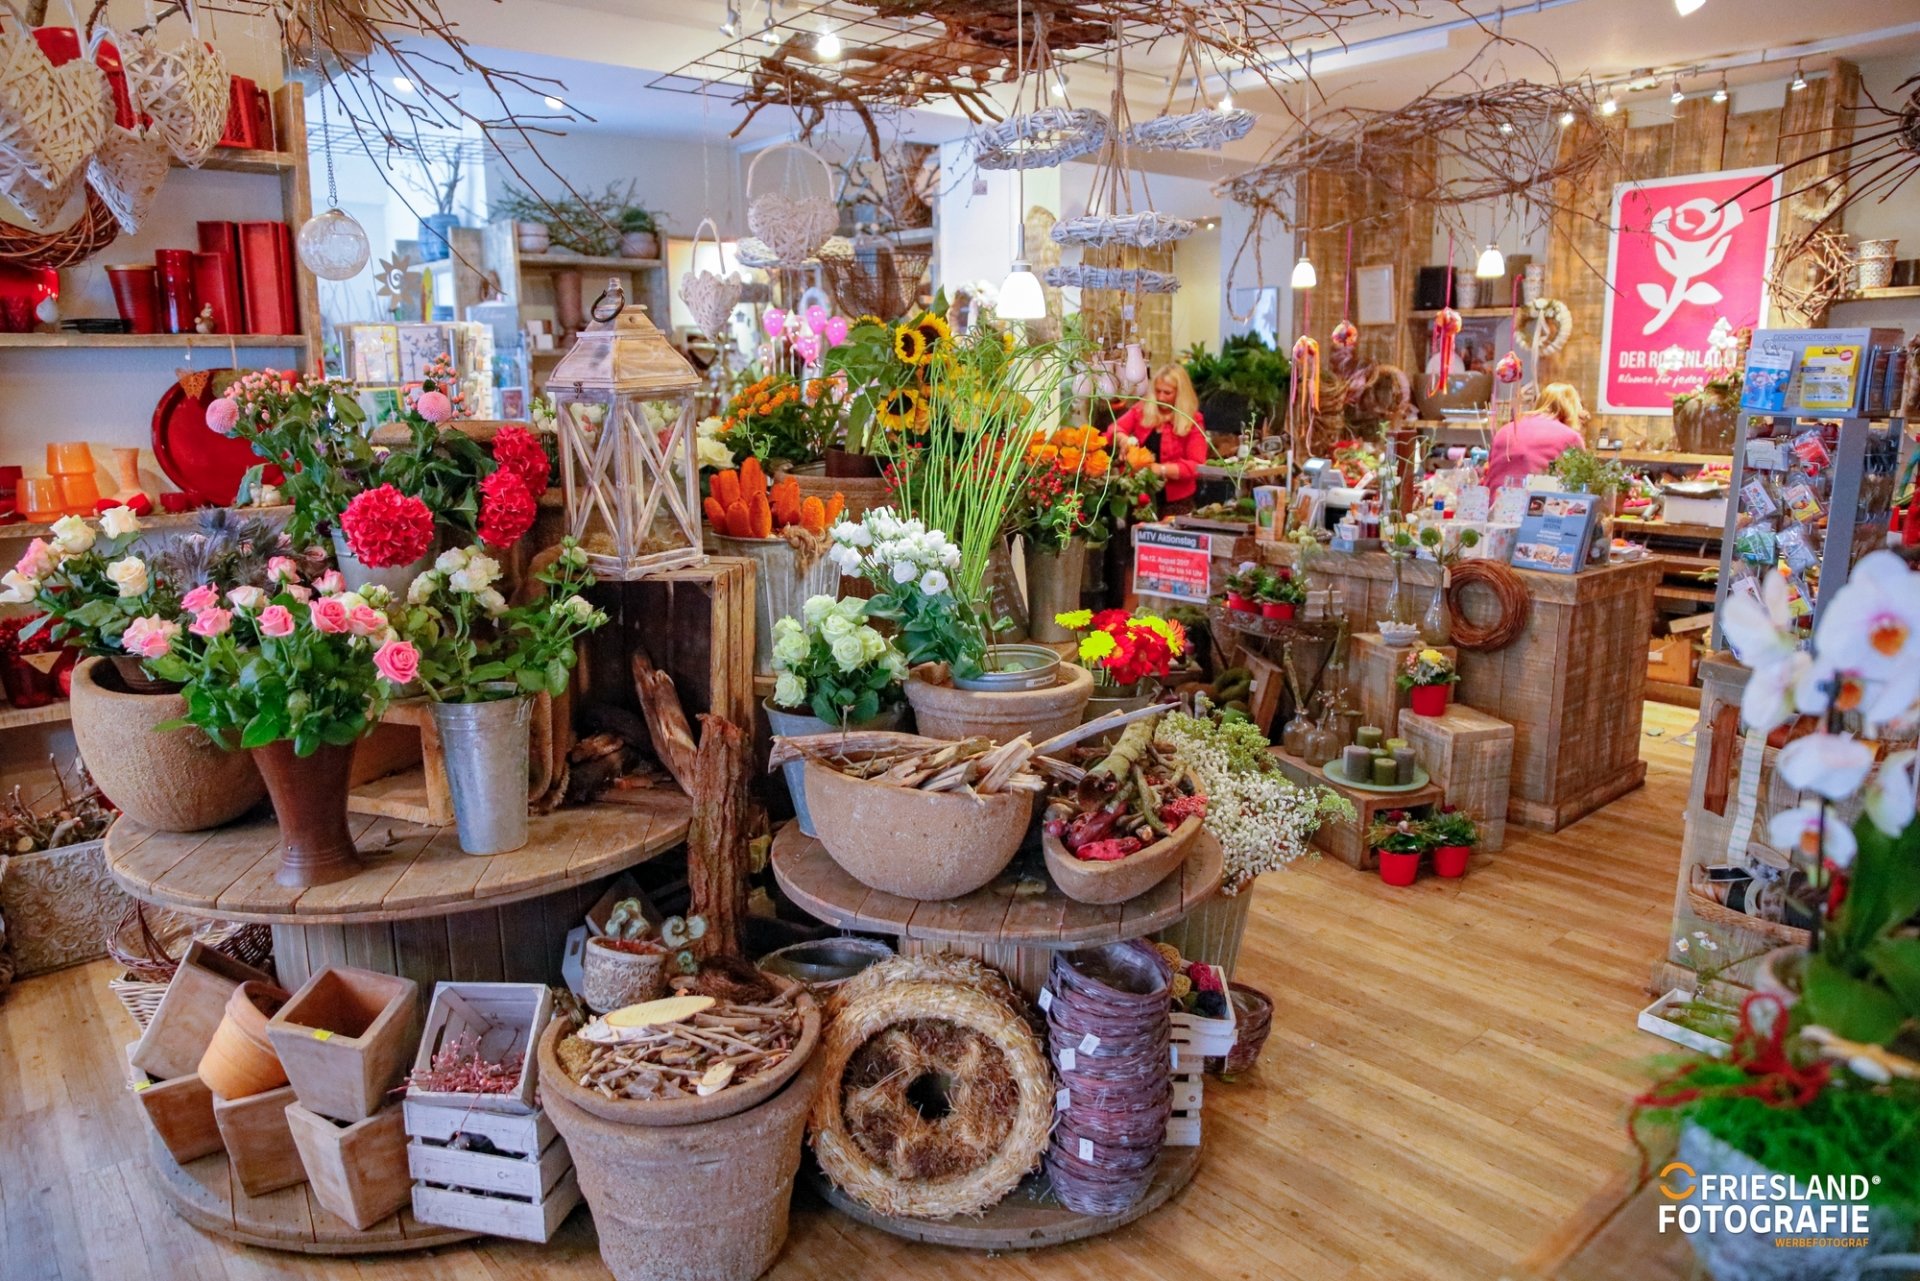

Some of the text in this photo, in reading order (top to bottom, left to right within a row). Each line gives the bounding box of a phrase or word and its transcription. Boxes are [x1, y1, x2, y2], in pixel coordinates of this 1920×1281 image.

[1619, 351, 1646, 369] DER
[1617, 374, 1653, 384] Blumen
[1138, 531, 1196, 548] MTV Aktionstag
